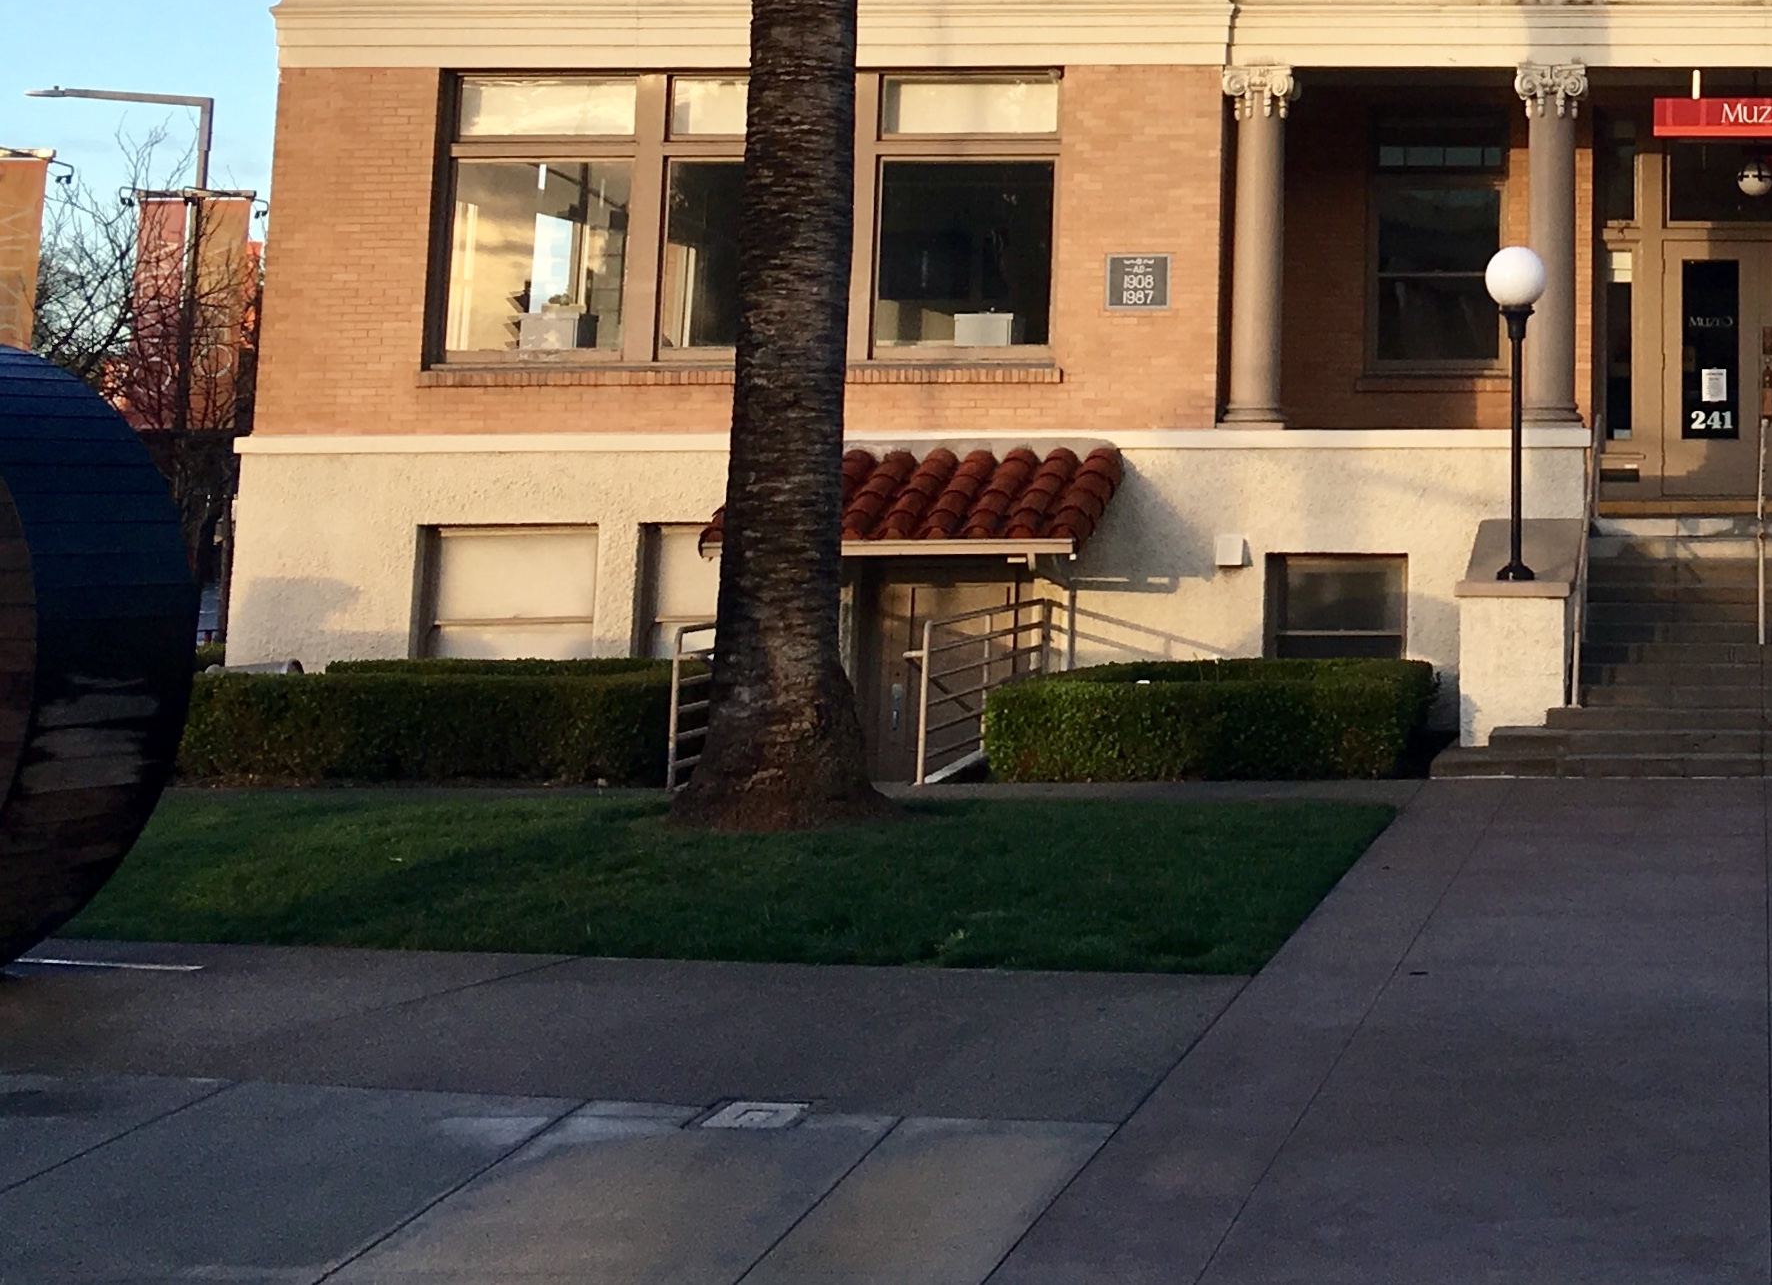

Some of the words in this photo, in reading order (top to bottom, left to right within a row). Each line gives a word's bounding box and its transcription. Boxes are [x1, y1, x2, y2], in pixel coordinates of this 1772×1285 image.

[1122, 274, 1155, 289] 1908
[1122, 289, 1155, 305] 1987
[1690, 410, 1733, 430] 241
